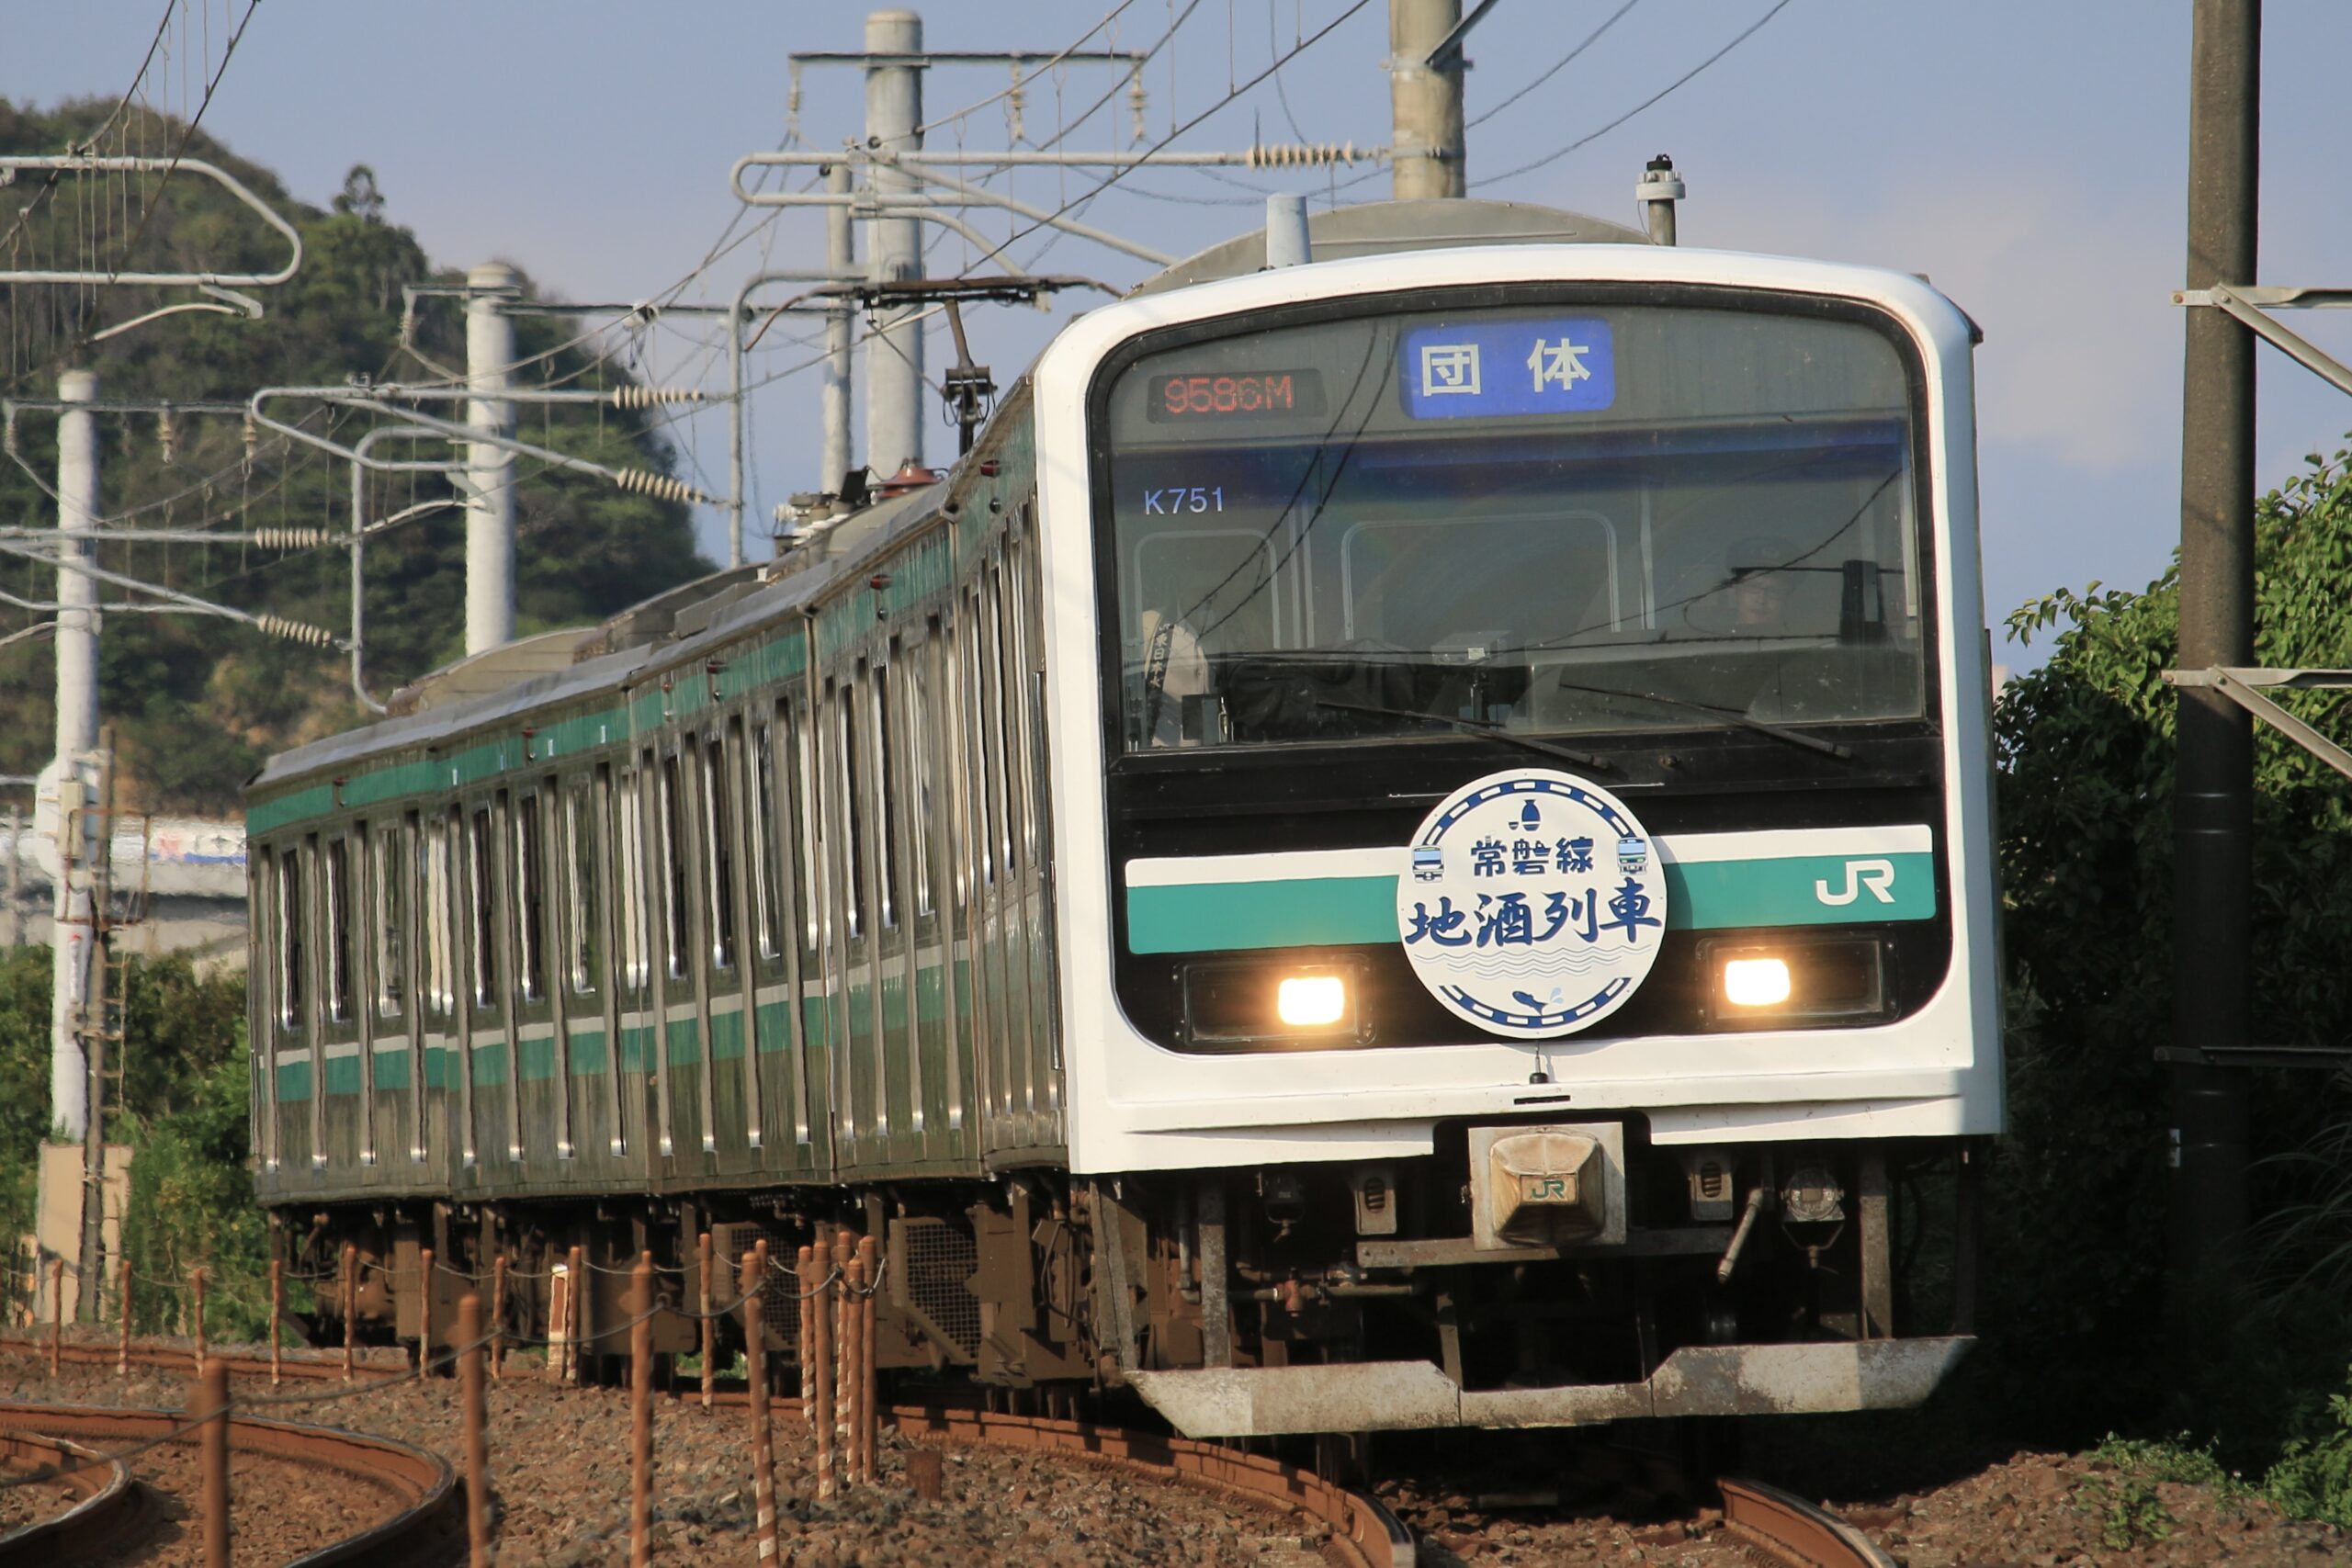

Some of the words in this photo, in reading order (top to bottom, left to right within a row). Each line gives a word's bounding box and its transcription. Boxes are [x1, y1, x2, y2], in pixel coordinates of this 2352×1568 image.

[1164, 375, 1294, 414] 9586M
[1145, 486, 1224, 515] K751
[1470, 836, 1595, 877] 常磐線
[1815, 859, 1895, 906] JR
[1404, 876, 1662, 948] 地酒列車
[1532, 1179, 1565, 1200] JR
